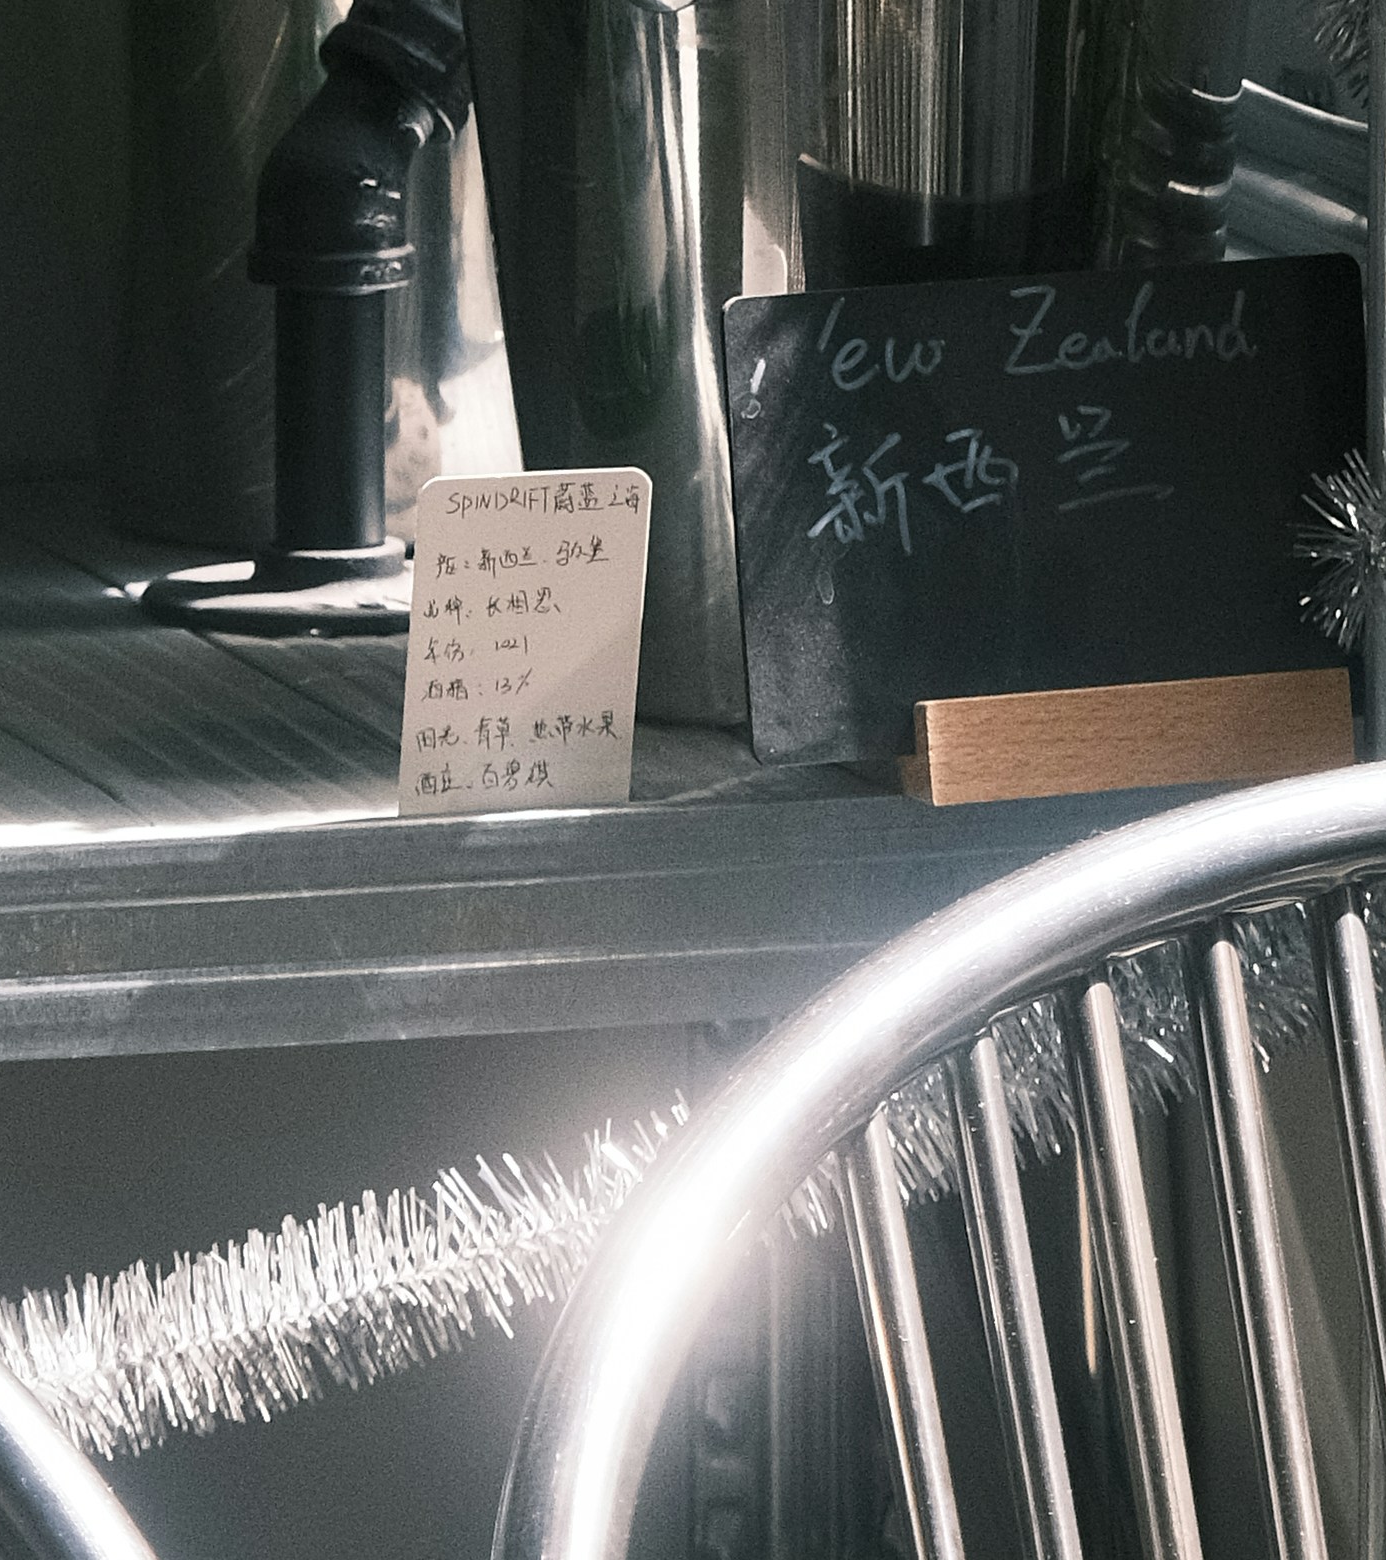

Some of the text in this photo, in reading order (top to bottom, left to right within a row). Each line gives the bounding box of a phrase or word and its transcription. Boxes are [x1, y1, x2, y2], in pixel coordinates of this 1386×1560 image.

[1004, 280, 1260, 377] Zealand
[806, 406, 1176, 556] 新西兰
